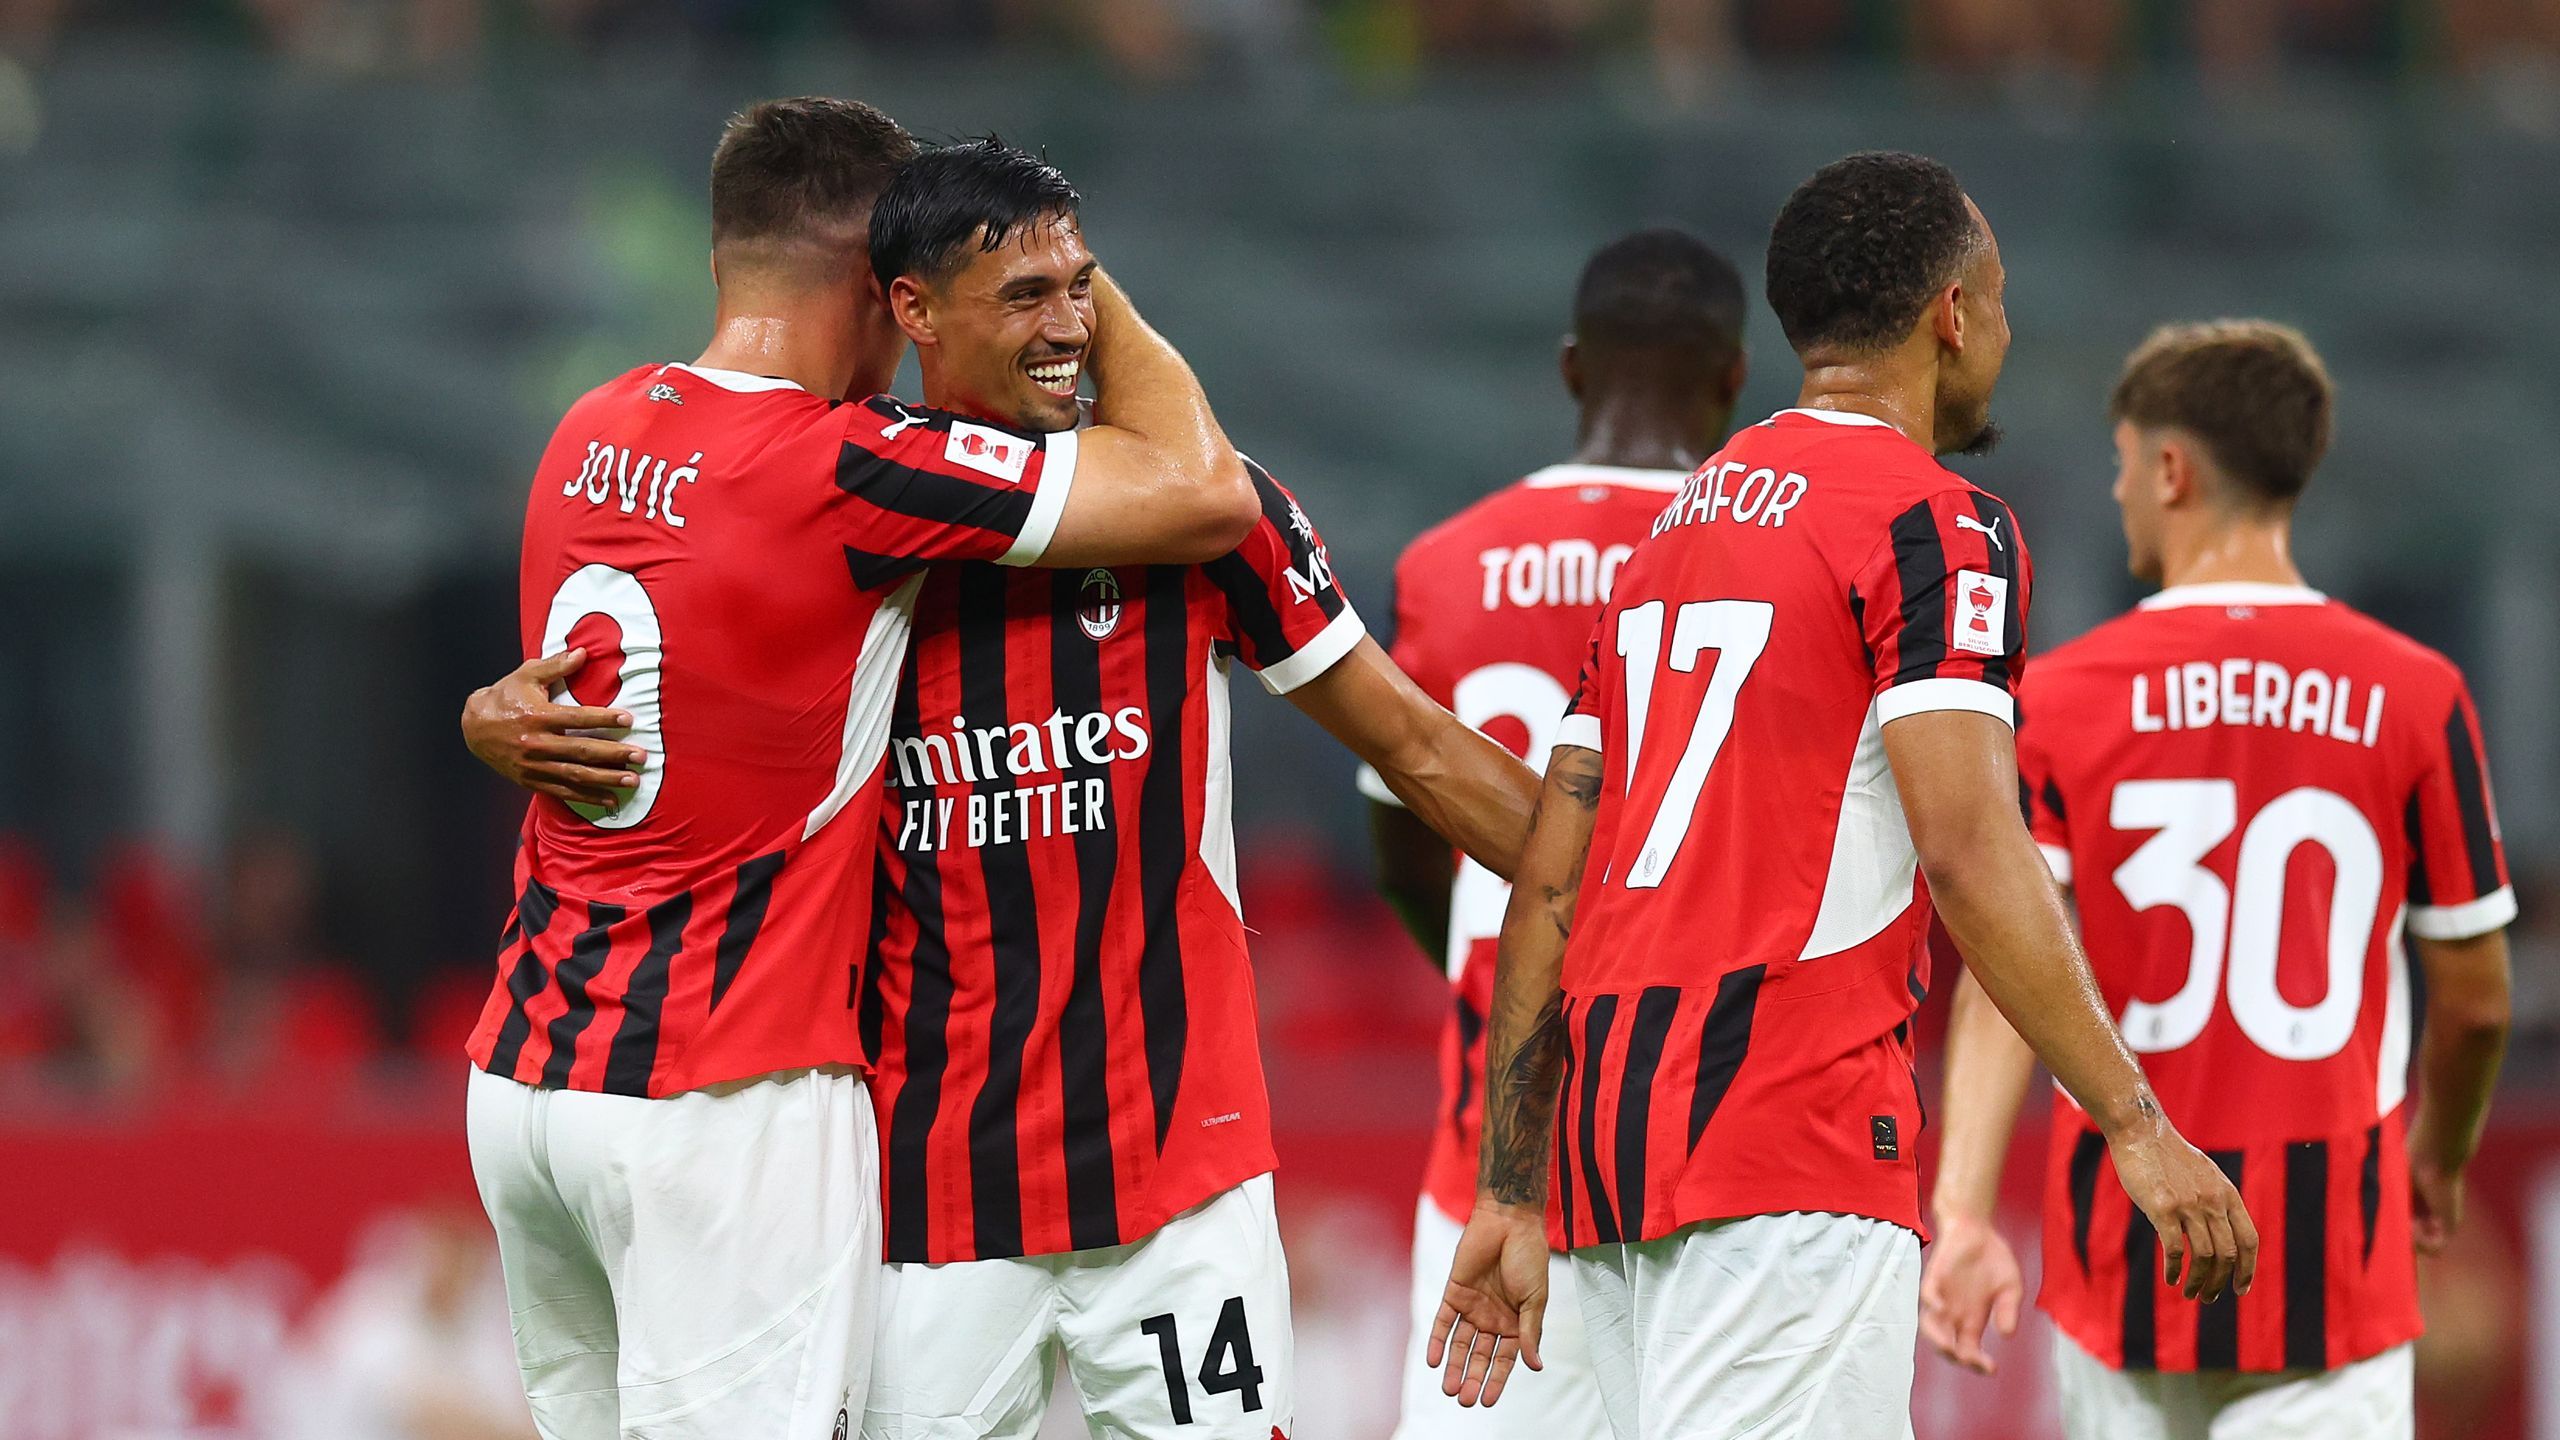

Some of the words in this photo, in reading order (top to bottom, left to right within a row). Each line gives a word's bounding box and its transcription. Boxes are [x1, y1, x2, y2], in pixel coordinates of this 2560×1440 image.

[562, 440, 704, 529] JOVIĆ
[1086, 569, 1114, 585] ACM
[1478, 538, 1637, 612] TOMO
[1088, 622, 1111, 632] 1899
[1967, 638, 1989, 647] SILVIO
[541, 562, 666, 829] 9
[2131, 658, 2386, 749] LIBERALI
[884, 705, 1150, 788] mirates
[1603, 598, 1775, 889] 17
[898, 798, 955, 852] FLY
[967, 777, 1107, 849] BETTER
[2108, 776, 2385, 1062] 30
[1140, 1295, 1264, 1426] 14
